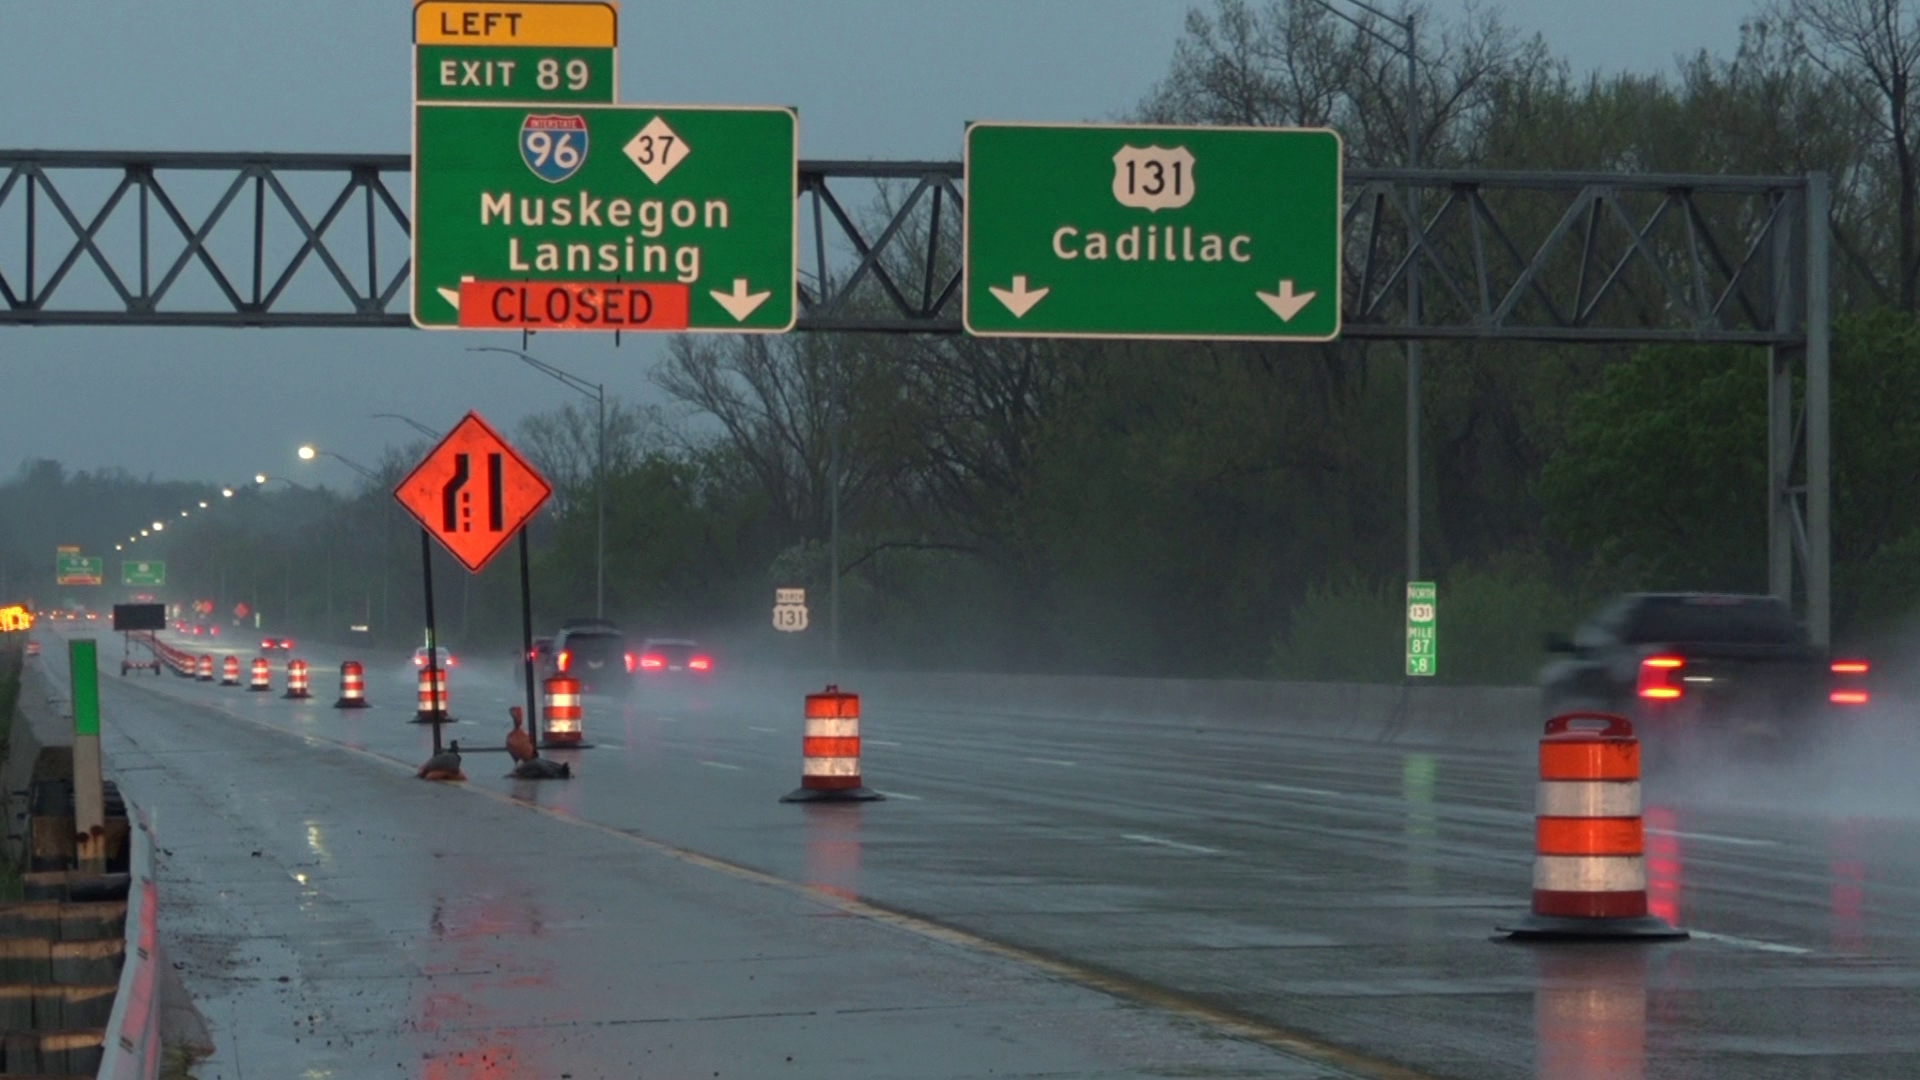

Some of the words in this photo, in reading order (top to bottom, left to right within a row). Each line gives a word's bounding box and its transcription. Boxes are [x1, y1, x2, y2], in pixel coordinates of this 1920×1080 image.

[440, 12, 522, 36] LEFT
[439, 60, 516, 86] EXIT
[536, 58, 589, 90] 89
[531, 119, 577, 129] INTERSTATE
[526, 131, 579, 169] 96
[637, 135, 675, 166] 37
[1126, 159, 1182, 196] 131
[480, 190, 729, 237] Muskegon
[1052, 225, 1252, 262] Cadillac
[509, 236, 700, 283] Lansing
[491, 286, 654, 326] CLOSED
[778, 610, 803, 626] 131
[1413, 606, 1430, 618] 131
[1408, 627, 1432, 638] MILE
[1412, 639, 1430, 653] 87
